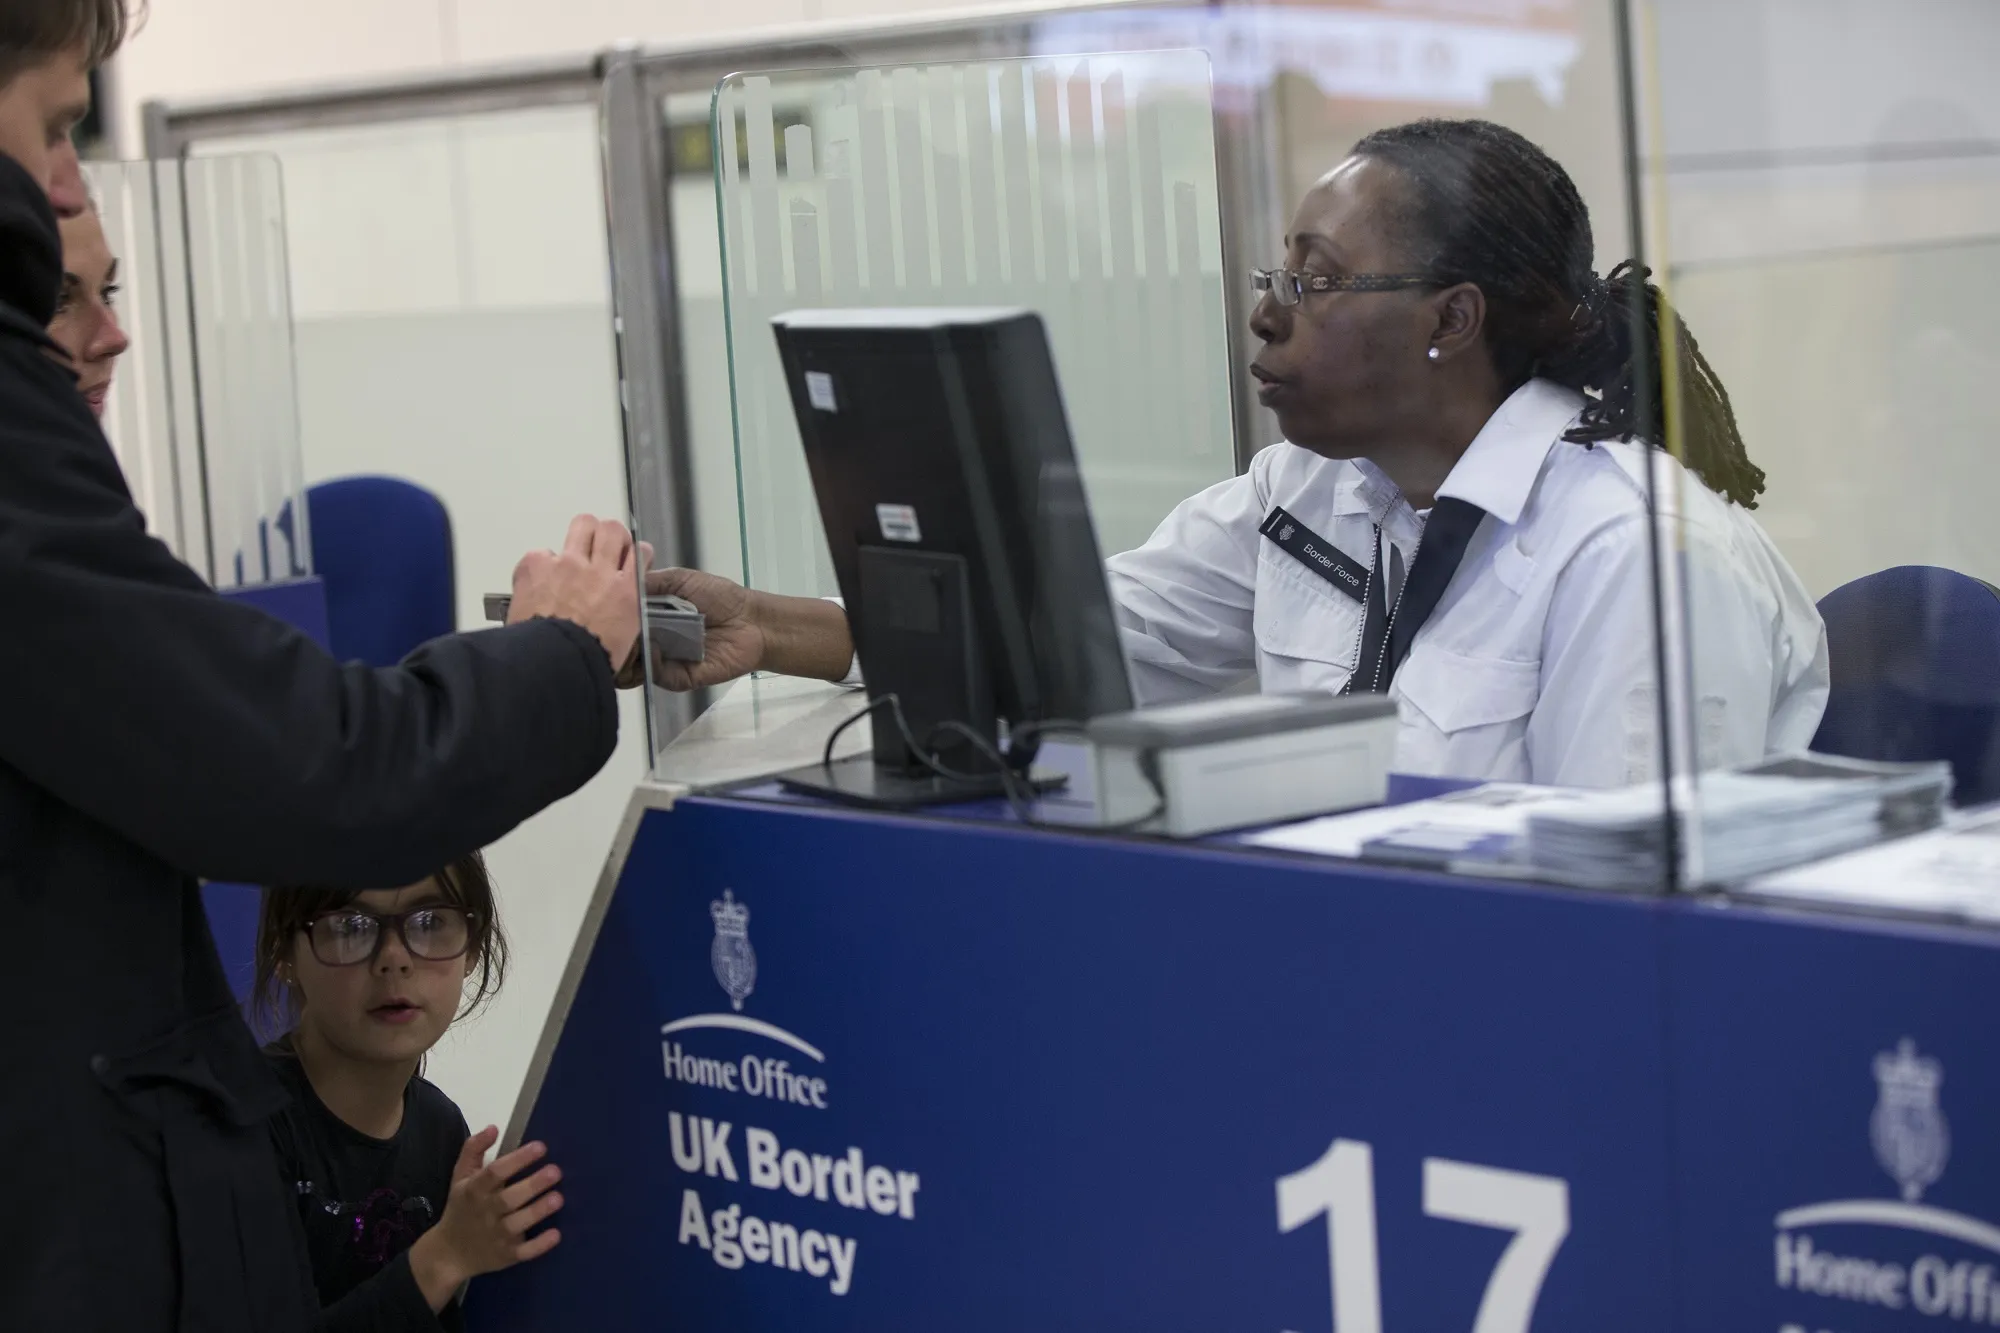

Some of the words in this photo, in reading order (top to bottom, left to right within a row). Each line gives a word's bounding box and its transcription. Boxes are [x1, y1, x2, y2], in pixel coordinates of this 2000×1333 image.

[1303, 543, 1335, 569] Border
[1333, 564, 1360, 587] Force
[661, 1040, 739, 1093] Home
[741, 1054, 828, 1109] Office
[668, 1110, 739, 1183] UK
[745, 1126, 920, 1220] Border
[678, 1188, 857, 1296] Agency
[1275, 1137, 1571, 1333] 17
[1774, 1232, 1906, 1310] Home
